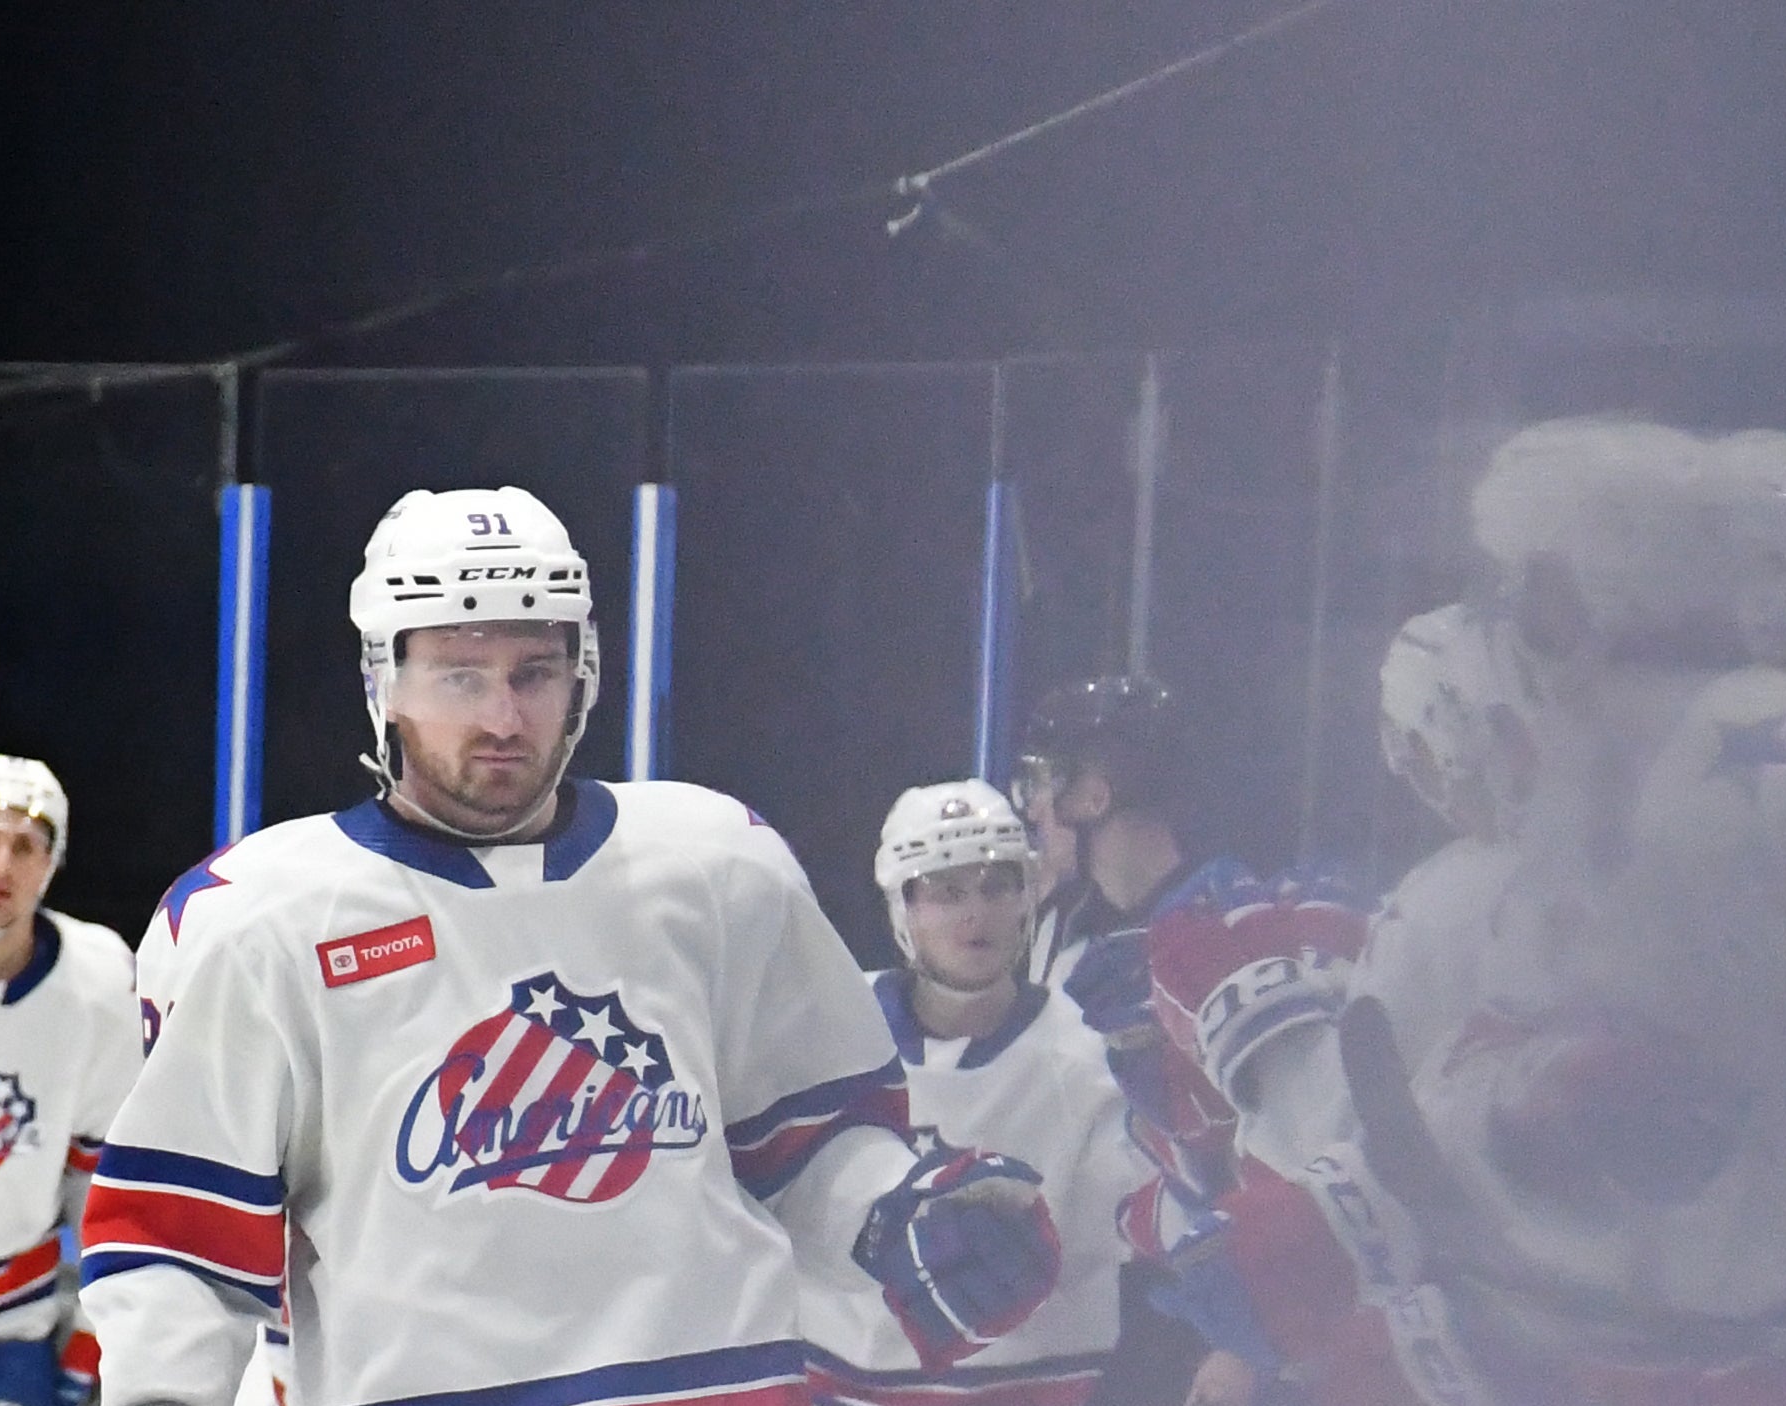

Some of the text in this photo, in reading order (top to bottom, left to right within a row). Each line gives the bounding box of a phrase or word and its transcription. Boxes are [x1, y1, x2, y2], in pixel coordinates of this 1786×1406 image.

[467, 512, 512, 536] 91
[458, 566, 537, 581] CCM
[360, 934, 424, 961] TOYOTA
[396, 1053, 708, 1194] Americans
